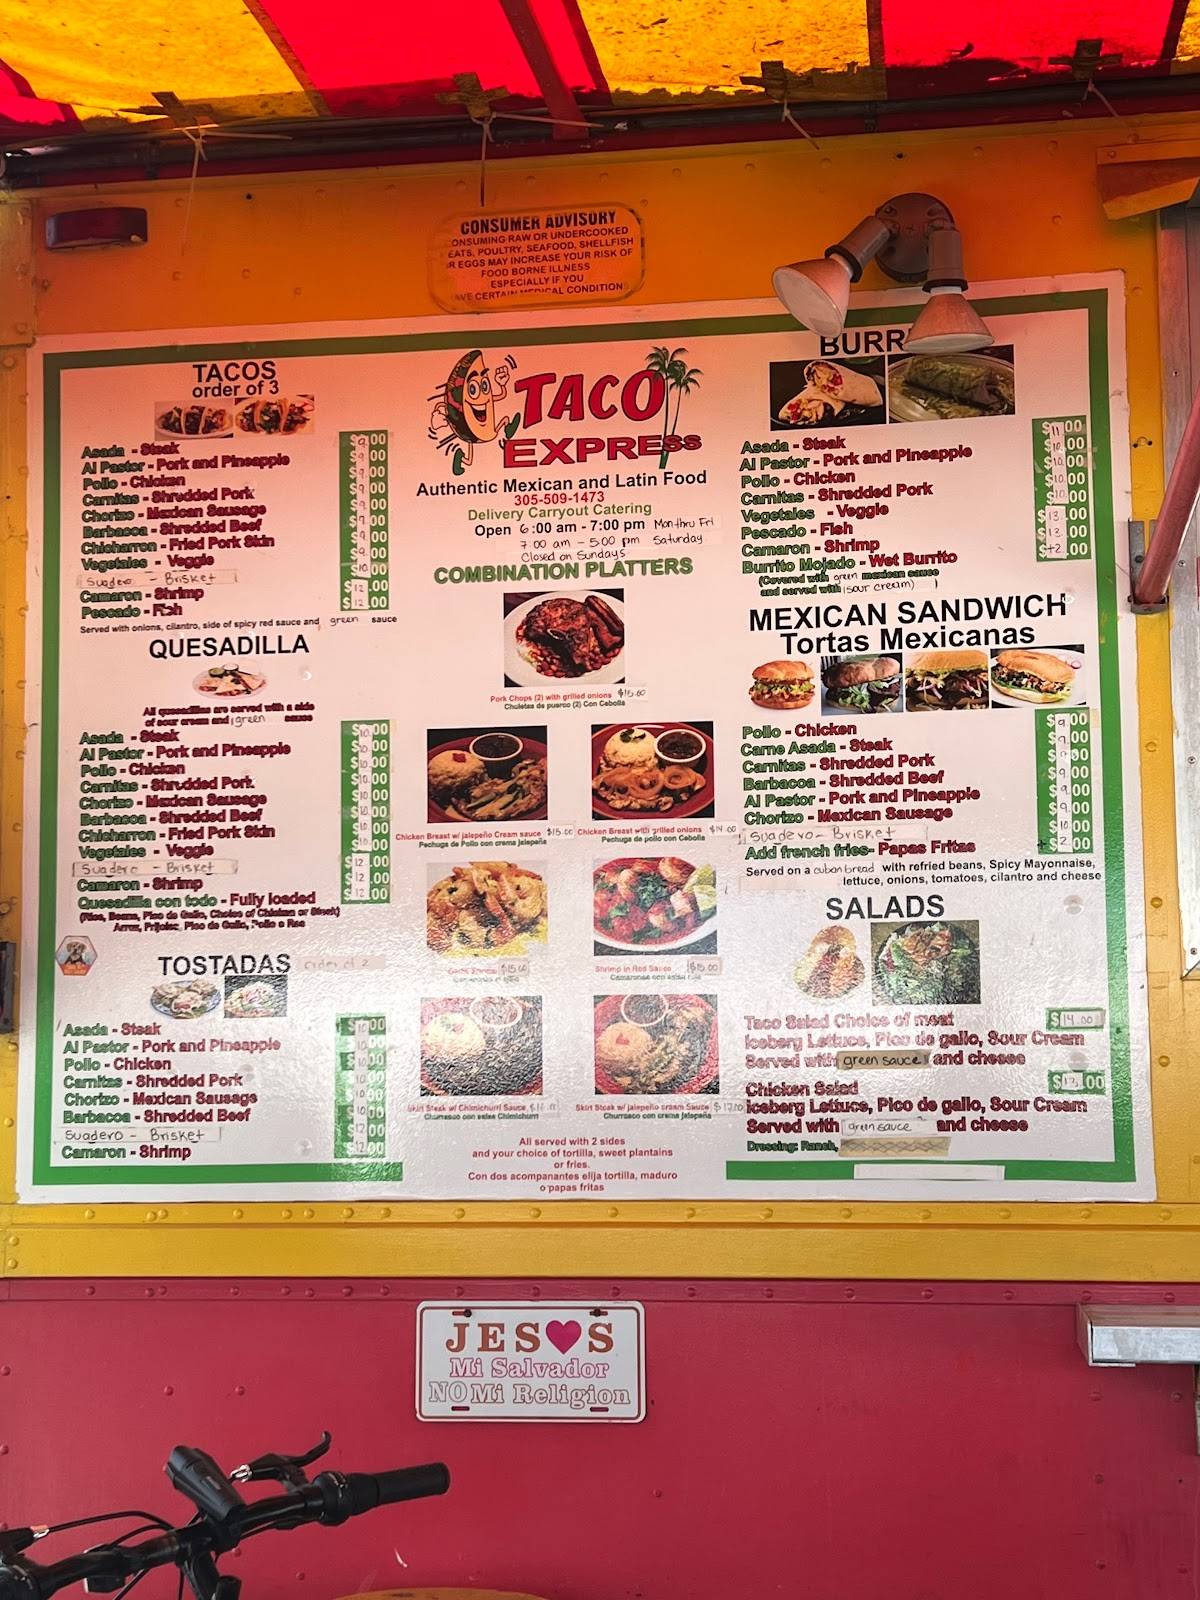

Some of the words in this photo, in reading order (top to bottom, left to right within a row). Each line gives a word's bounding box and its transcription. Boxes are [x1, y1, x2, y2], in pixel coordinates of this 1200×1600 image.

[461, 216, 540, 234] CONSUMER
[545, 211, 615, 228] ADVISORY
[508, 232, 530, 242] RAW
[533, 232, 547, 240] OR
[550, 226, 628, 239] UNDERCOOKED
[478, 245, 523, 255] POULTRY,
[526, 241, 576, 252] SEAFOOD,
[579, 237, 633, 248] SHELLFISH
[458, 259, 485, 268] EGGS
[488, 257, 507, 265] MAY
[510, 253, 560, 264] INCREASE
[563, 251, 590, 260] YOUR
[594, 249, 616, 258] RISK
[620, 248, 632, 256] OF
[481, 268, 508, 277] FOOD
[511, 265, 546, 275] BORNE
[549, 262, 590, 272] ILLNESS
[490, 277, 549, 288] ESPECIALLY
[552, 275, 560, 283] IF
[562, 274, 583, 282] YOU
[566, 282, 624, 293] CONDITION
[820, 328, 903, 356] BURR
[192, 360, 275, 383] TACOS
[192, 382, 240, 397] order
[246, 381, 263, 397] of
[269, 380, 278, 394] 3
[515, 370, 665, 428] TACO
[504, 435, 702, 468] EXPRESS
[739, 457, 755, 471] Al
[760, 455, 810, 470] Pastor
[823, 452, 859, 466] Pork
[862, 449, 891, 464] and
[896, 445, 972, 462] Pineapple
[416, 480, 497, 495] Authentic
[504, 477, 572, 492] Mexican
[578, 474, 608, 489] and
[616, 472, 656, 486] Latin
[664, 470, 706, 484] Food
[515, 492, 604, 505] 305-509-1473
[468, 509, 523, 520] Delivery
[528, 505, 588, 519] Carryout
[593, 503, 651, 515] Catering
[474, 524, 510, 537] Open
[520, 522, 551, 533] 6:00
[556, 523, 576, 532] am
[590, 519, 618, 530] 7:00
[624, 520, 644, 532] pm
[699, 517, 713, 526] Fri
[552, 539, 570, 548] am
[622, 536, 639, 547] pm
[653, 533, 702, 544] Saturday
[521, 551, 554, 562] Closed
[576, 550, 626, 560] Sundays
[742, 559, 795, 573] Burrito
[799, 556, 855, 571] Mojado
[868, 554, 899, 567] Wet
[903, 552, 957, 565] Burrito
[434, 562, 578, 583] COMBINATION
[585, 557, 692, 577] PLATTERS
[750, 603, 885, 630] MEXICAN
[897, 594, 1065, 623] SANDWICH
[80, 625, 109, 633] Served
[166, 622, 200, 630] cilantro,
[234, 620, 256, 628] spicy
[303, 617, 319, 627] and
[330, 616, 358, 626] green
[371, 616, 397, 624] sauce
[149, 634, 309, 658] QUESADILLA
[780, 632, 869, 654] Tortas
[880, 627, 1034, 649] Mexicanas
[740, 743, 785, 756] Carne
[788, 740, 836, 754] Asada
[849, 737, 892, 751] Steak
[744, 844, 776, 859] Add
[780, 844, 830, 858] french
[878, 842, 926, 856] Papas
[931, 839, 976, 853] Fritas
[746, 866, 783, 876] Served
[844, 863, 874, 872] bread
[882, 862, 905, 874] with
[909, 860, 944, 870] refried
[948, 860, 985, 869] beans,
[989, 859, 1020, 872] Spicy
[1024, 858, 1094, 871] Mayonnaise,
[843, 876, 882, 885] lettuce,
[886, 875, 927, 884] onions,
[931, 873, 986, 882] tomatoes,
[990, 872, 1032, 881] cilantro
[1036, 871, 1057, 880] and
[1061, 871, 1101, 880] cheese
[826, 894, 944, 919] SALADS
[158, 954, 291, 976] TOSTADAS
[1050, 1012, 1092, 1027] $14.00
[64, 1058, 100, 1070] Pollo
[113, 1057, 171, 1070] Chicken
[745, 1081, 810, 1096] Chicken
[814, 1080, 858, 1095] Salad
[64, 1092, 119, 1105] Chorizo
[132, 1091, 191, 1105] Mexican
[195, 1091, 257, 1106] Sausage
[519, 1137, 531, 1145] All
[534, 1137, 566, 1145] served
[569, 1137, 588, 1145] with
[592, 1137, 596, 1145] 2
[600, 1137, 625, 1145] sides
[472, 1149, 489, 1157] and
[492, 1150, 514, 1159] your
[550, 1148, 560, 1156] of
[562, 1148, 595, 1157] tortilla,
[598, 1148, 626, 1156] sweet
[629, 1148, 672, 1158] plantains
[566, 1160, 589, 1168] fries.
[468, 1172, 487, 1180] Con
[490, 1172, 507, 1180] dos
[582, 1171, 601, 1182] elija
[604, 1171, 637, 1180] tortilla,
[640, 1170, 677, 1178] maduro
[580, 1182, 604, 1190] fritas
[449, 1357, 483, 1377] Mi
[491, 1357, 609, 1378] Salvador
[470, 1383, 504, 1403] Mi
[512, 1383, 631, 1408] Religion
